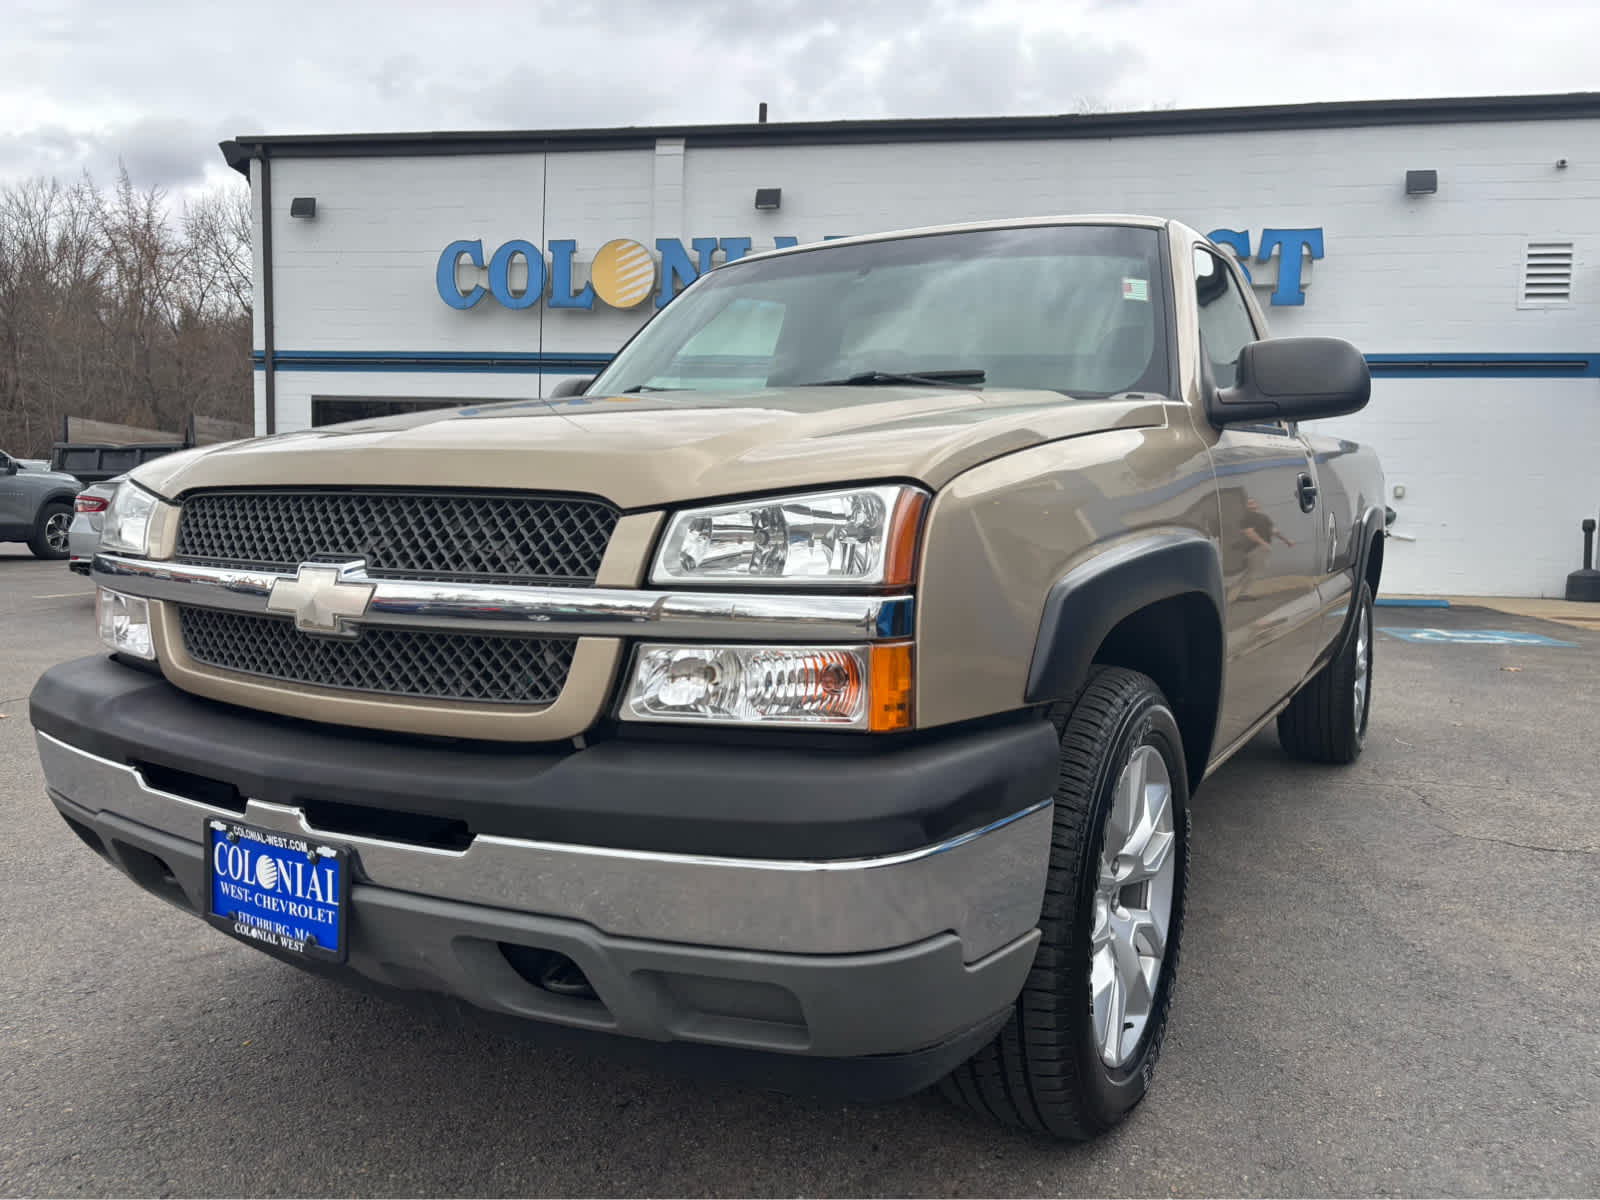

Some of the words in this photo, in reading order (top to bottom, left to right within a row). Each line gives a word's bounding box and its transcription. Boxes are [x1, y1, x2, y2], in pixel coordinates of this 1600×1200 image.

[233, 825, 308, 852] COLONIAL-WEST.COM
[213, 841, 339, 905] COLONIAL
[254, 893, 335, 925] CHEVROLET
[234, 923, 278, 945] COLONIAL
[280, 936, 305, 952] WEST
